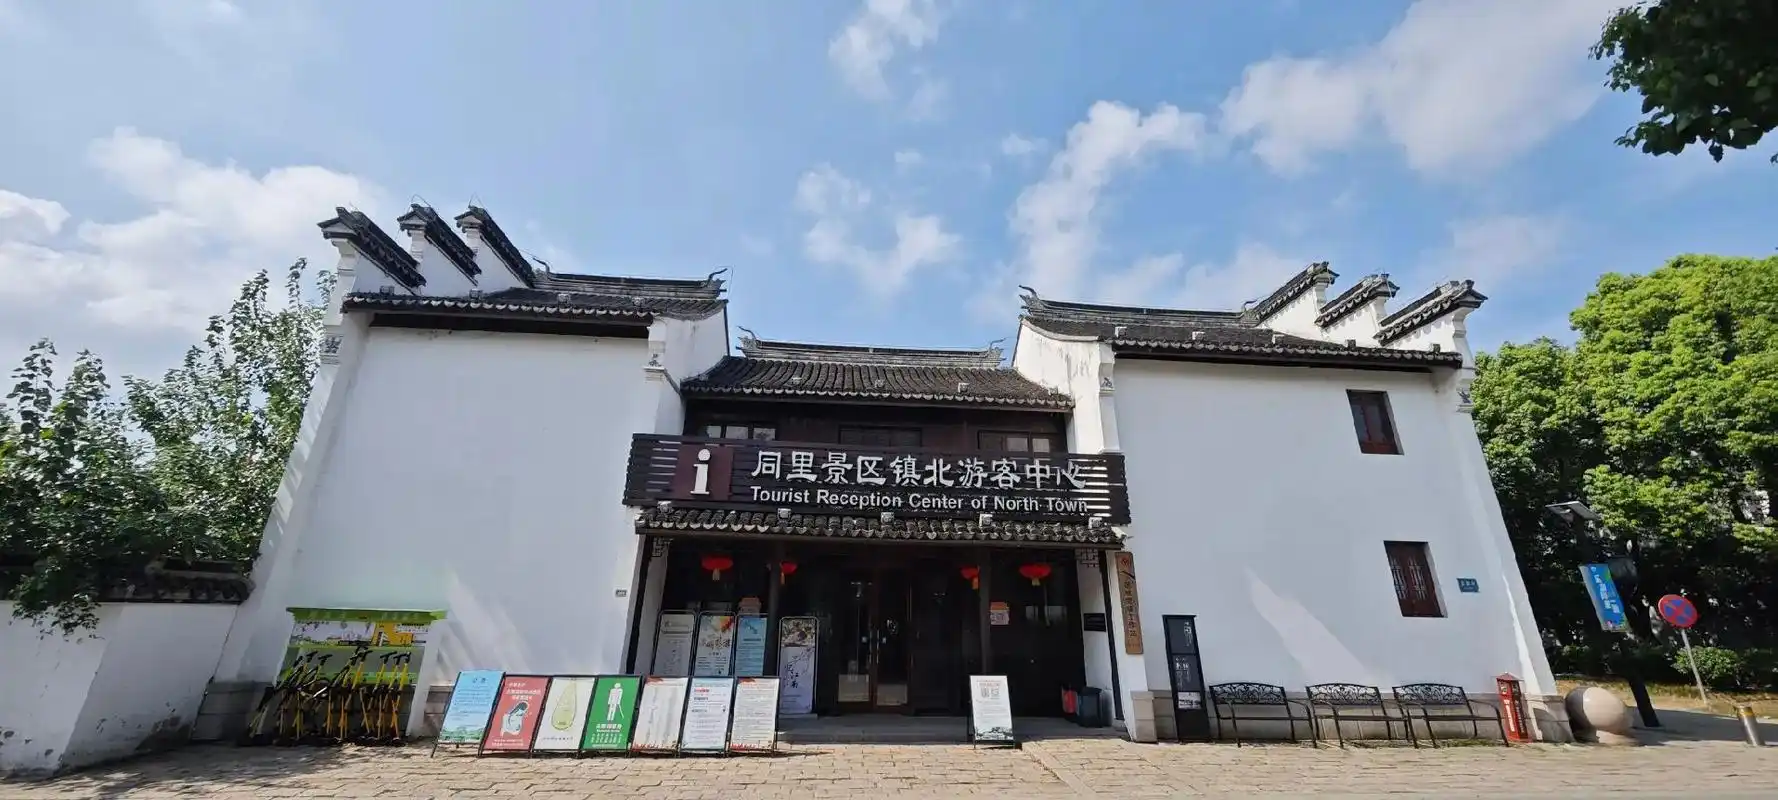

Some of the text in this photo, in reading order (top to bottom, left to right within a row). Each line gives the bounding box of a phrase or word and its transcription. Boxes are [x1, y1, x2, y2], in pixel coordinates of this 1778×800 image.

[751, 450, 1087, 489] 同里景区镇北游客中心
[750, 485, 1088, 513] Tourist Reception Center of North Town
